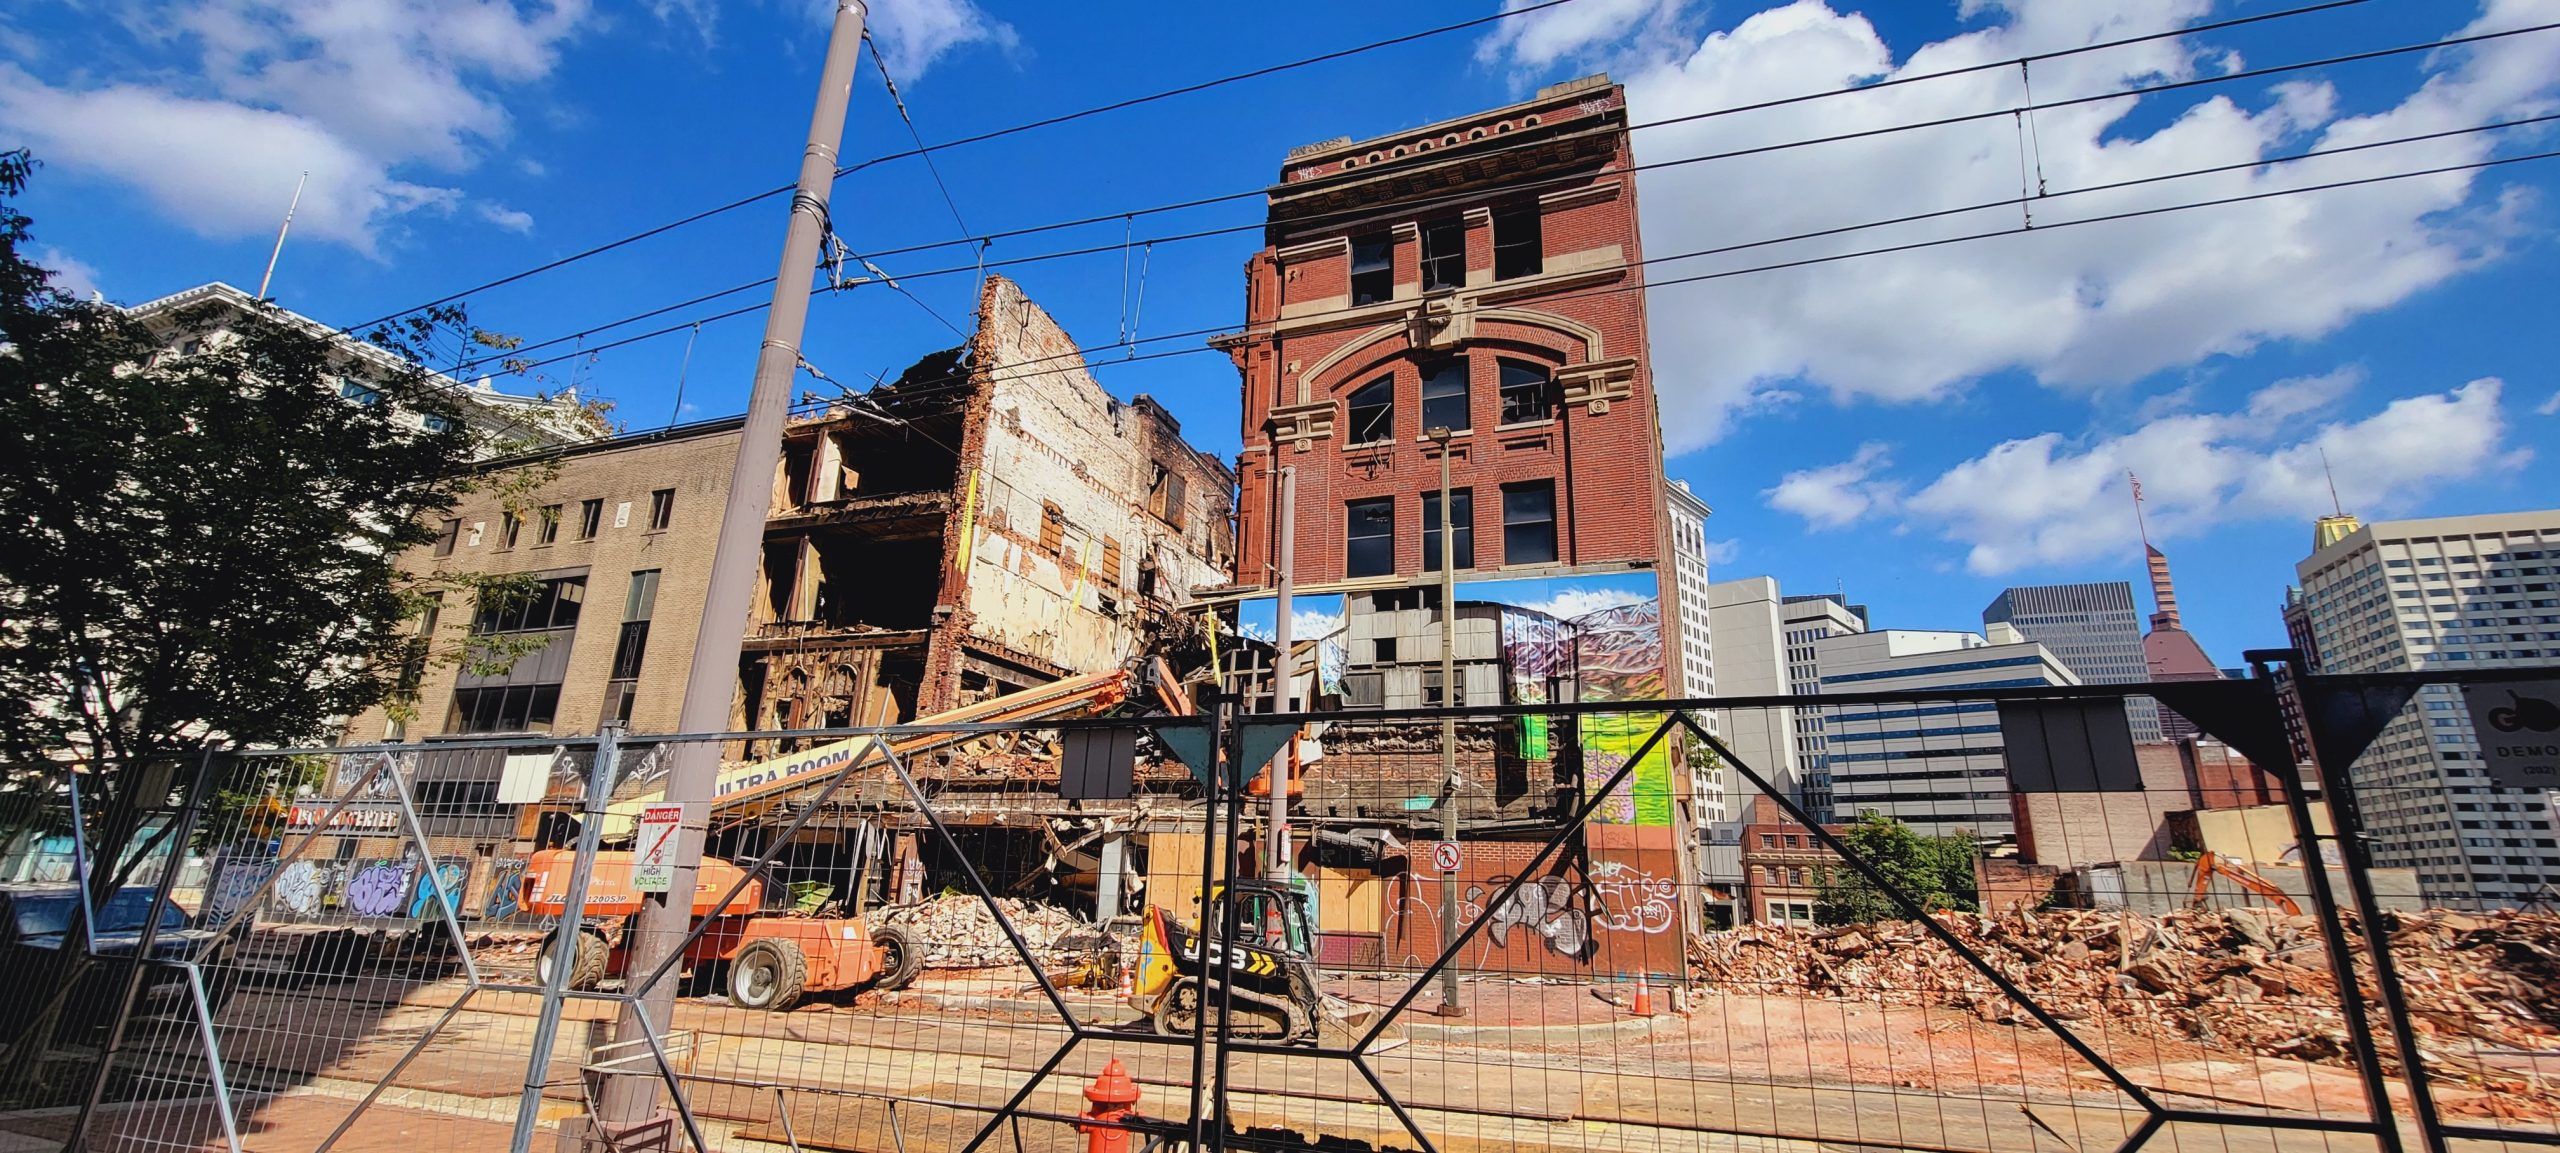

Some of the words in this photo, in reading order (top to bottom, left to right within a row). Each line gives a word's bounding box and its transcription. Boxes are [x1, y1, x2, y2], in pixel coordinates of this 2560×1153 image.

[786, 749, 850, 777] BOOM
[645, 811, 679, 820] DANGER
[643, 867, 661, 876] HIGH
[635, 876, 667, 886] VOLTAGE
[587, 895, 627, 903] 1200SJP
[1184, 939, 1247, 970] JCB
